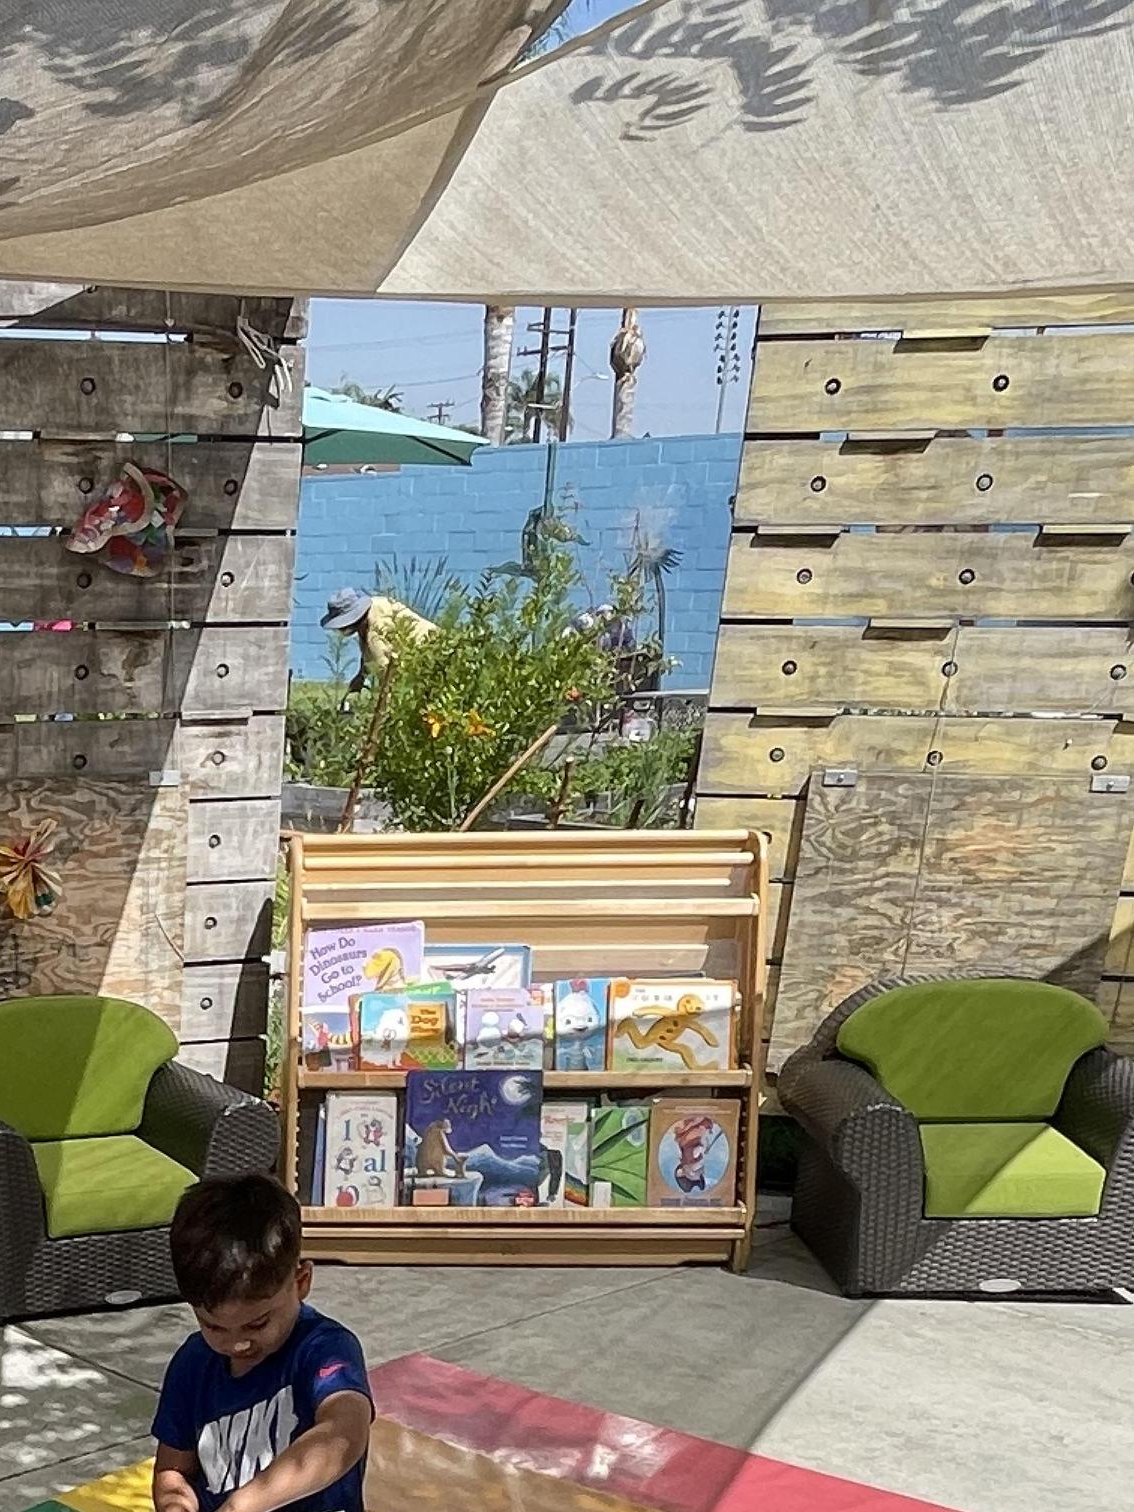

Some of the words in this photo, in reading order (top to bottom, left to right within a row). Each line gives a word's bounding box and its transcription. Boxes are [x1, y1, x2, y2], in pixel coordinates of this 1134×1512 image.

[310, 942, 336, 960] How
[338, 936, 355, 949] Do
[309, 950, 367, 976] Dinosaurs
[321, 970, 339, 984] Go
[341, 965, 355, 975] to
[410, 1015, 439, 1026] Dog
[419, 1076, 480, 1105] Silent
